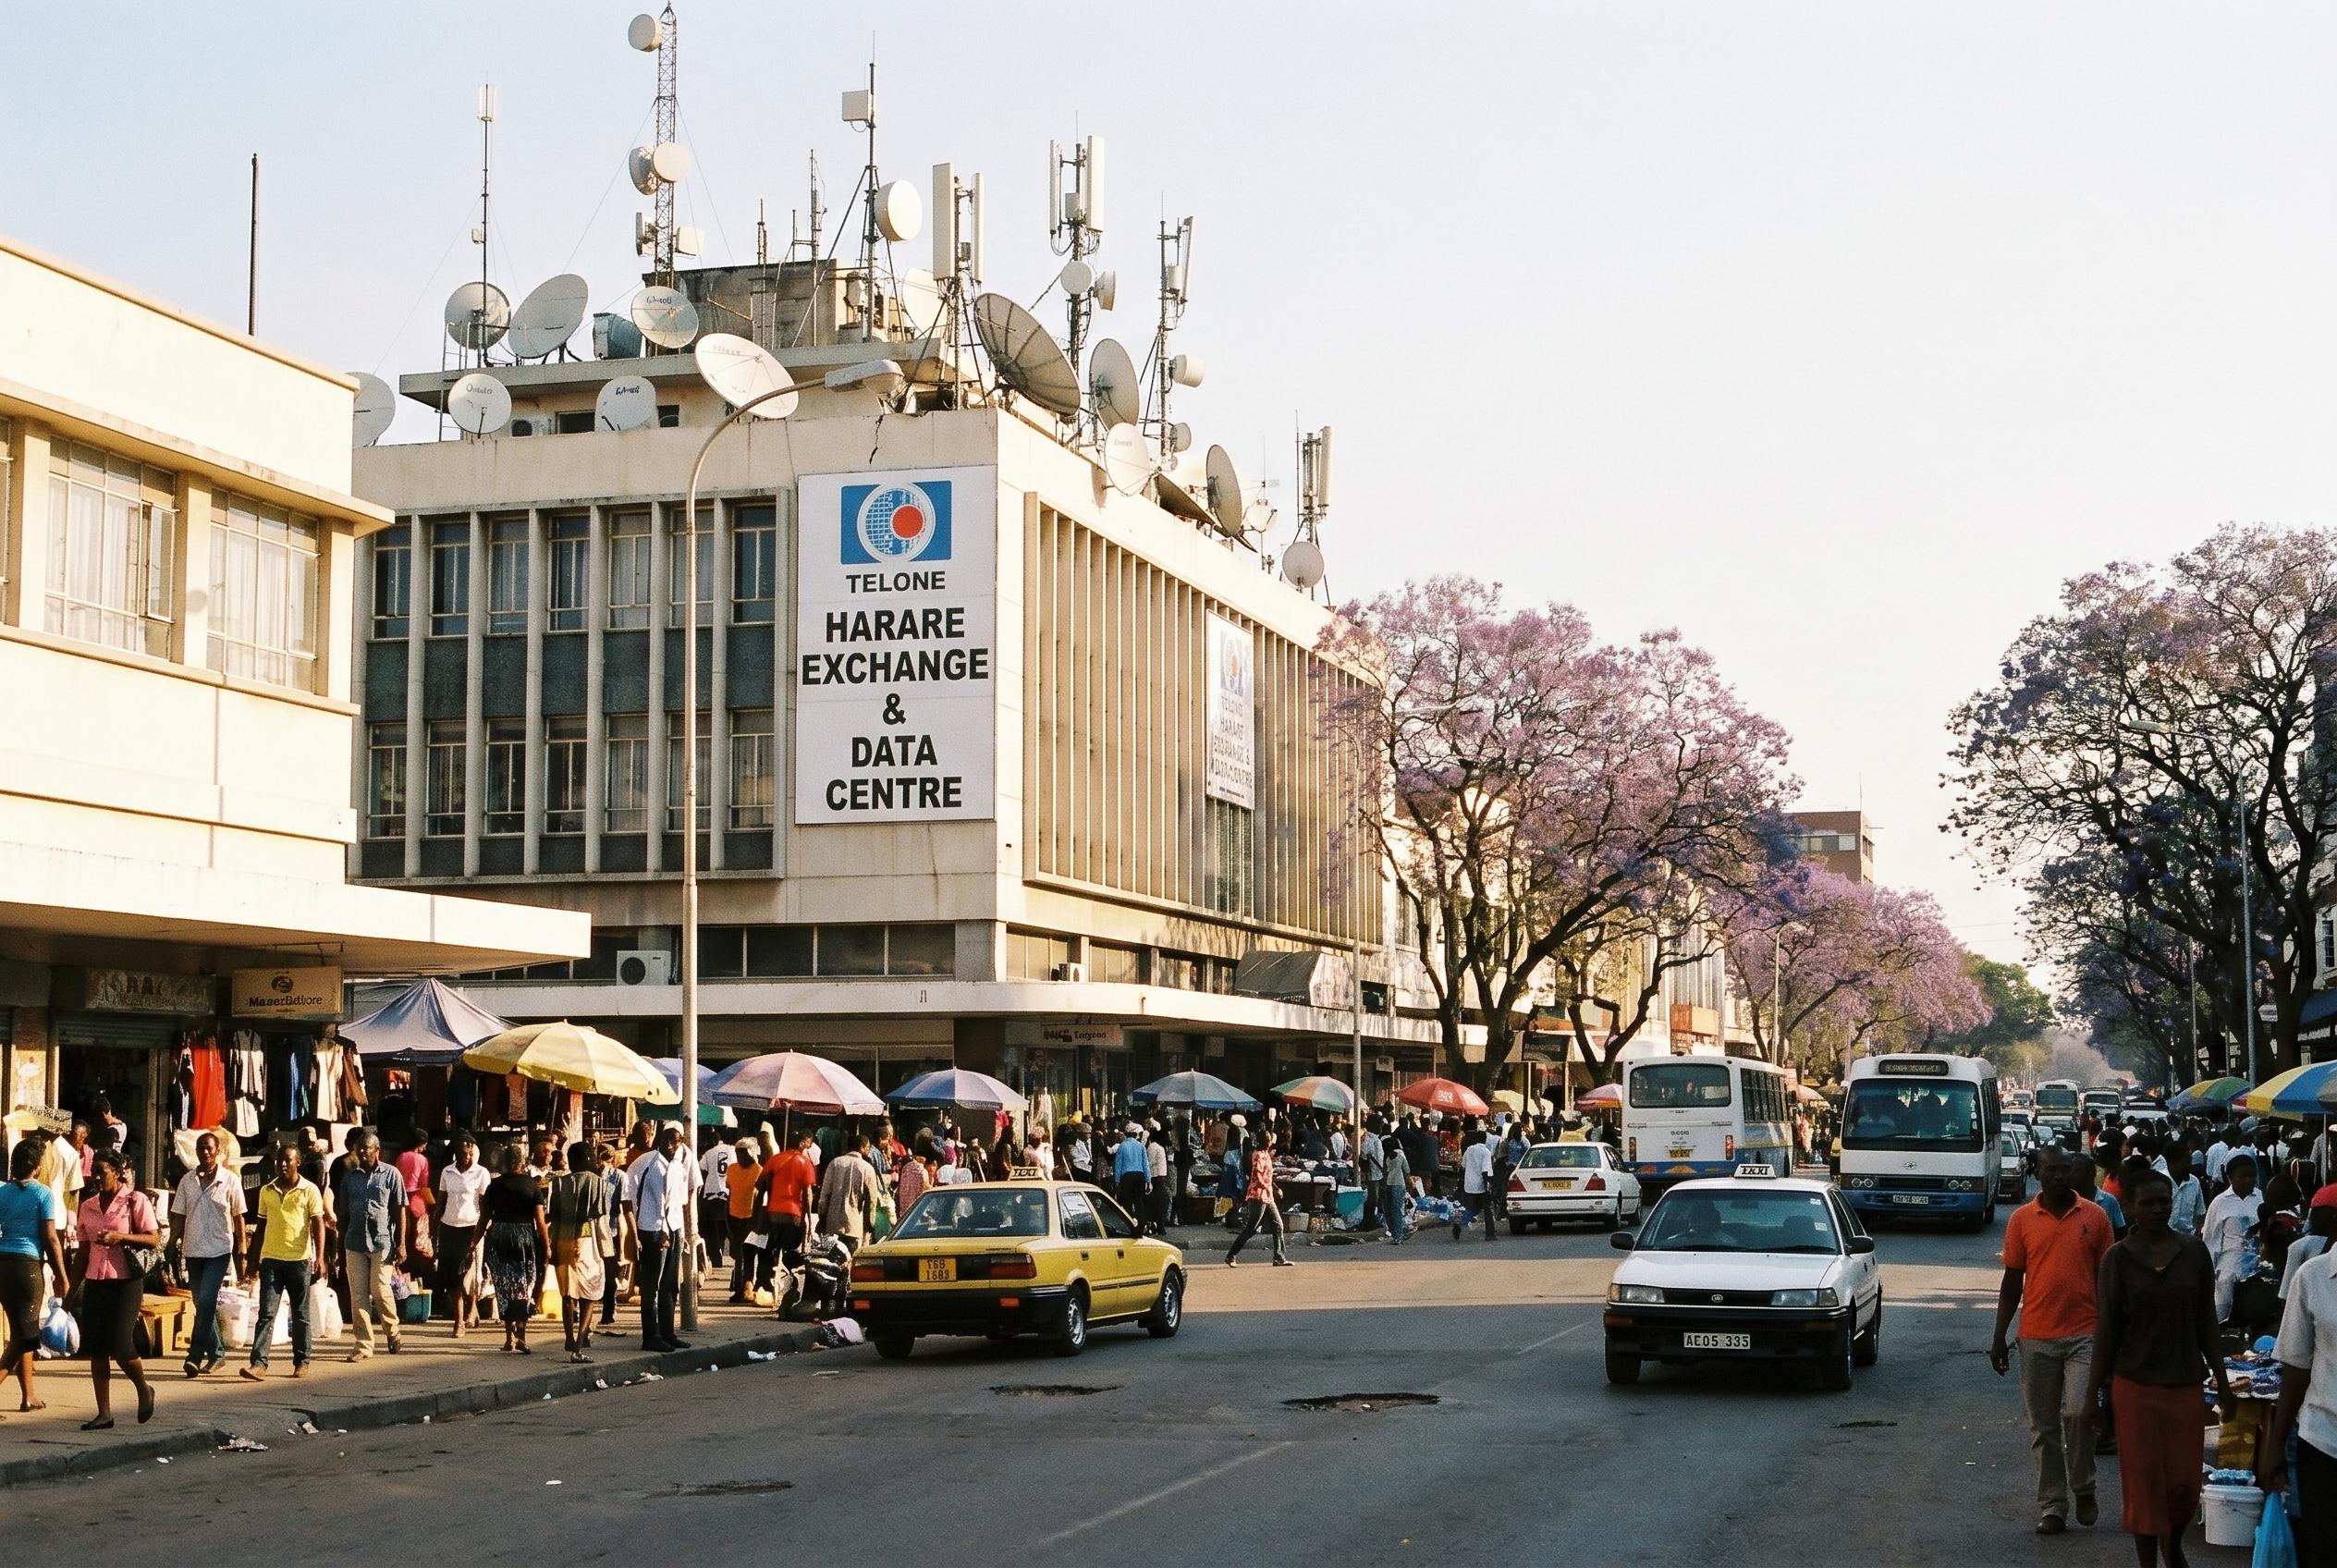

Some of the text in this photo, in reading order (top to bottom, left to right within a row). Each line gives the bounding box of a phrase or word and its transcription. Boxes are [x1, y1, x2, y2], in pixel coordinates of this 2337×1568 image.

[846, 571, 946, 594] TELONE
[826, 607, 965, 643] HARARE
[801, 648, 989, 686] EXCHANGE
[882, 693, 907, 726] &
[851, 734, 938, 768] DATA
[826, 777, 962, 811] CENTRE
[717, 1152, 728, 1175] 6
[1725, 1336, 1749, 1348] 335
